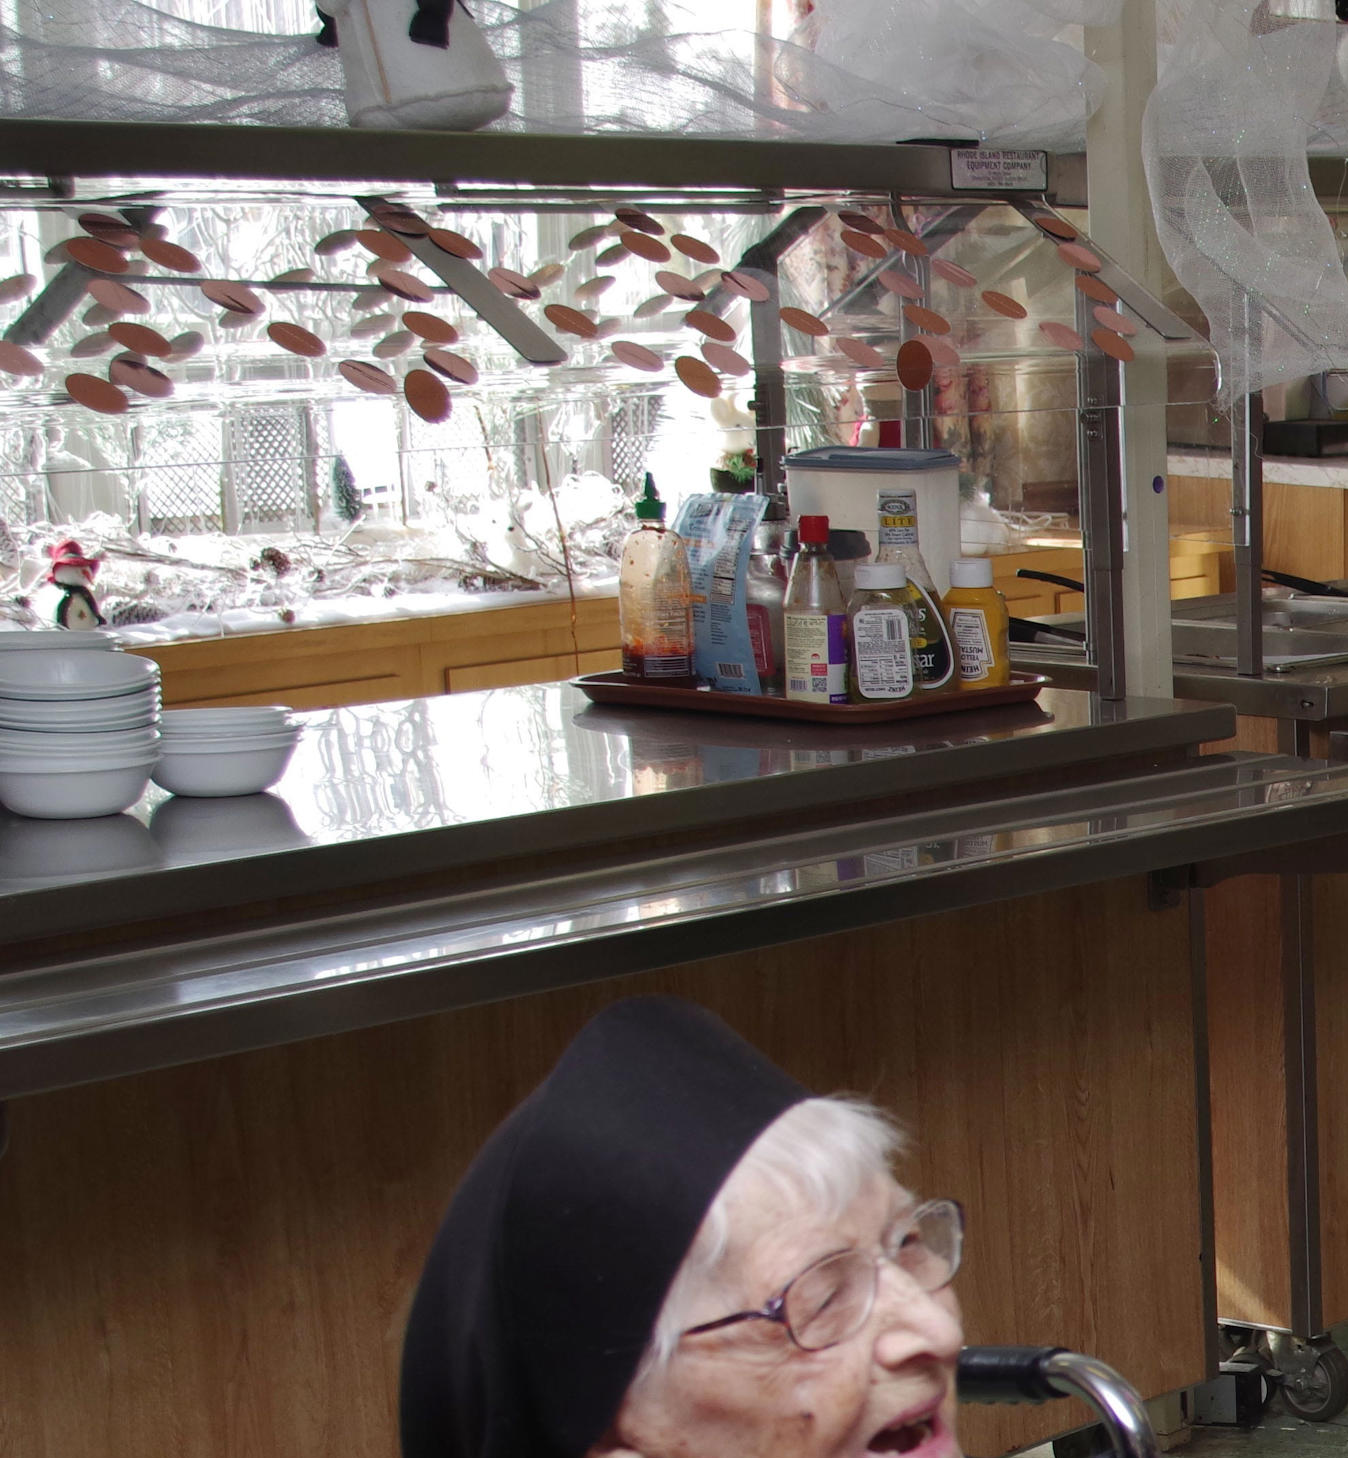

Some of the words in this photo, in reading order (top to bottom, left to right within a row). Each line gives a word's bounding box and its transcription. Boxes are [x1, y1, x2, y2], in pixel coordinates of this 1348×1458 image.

[980, 151, 1000, 160] ISLAND
[1002, 151, 1039, 160] RESTAURANT
[967, 161, 1001, 171] EQUIPMENT
[1003, 161, 1031, 170] COMPANY
[961, 654, 980, 662] YELLO
[961, 664, 980, 673] HEIN
